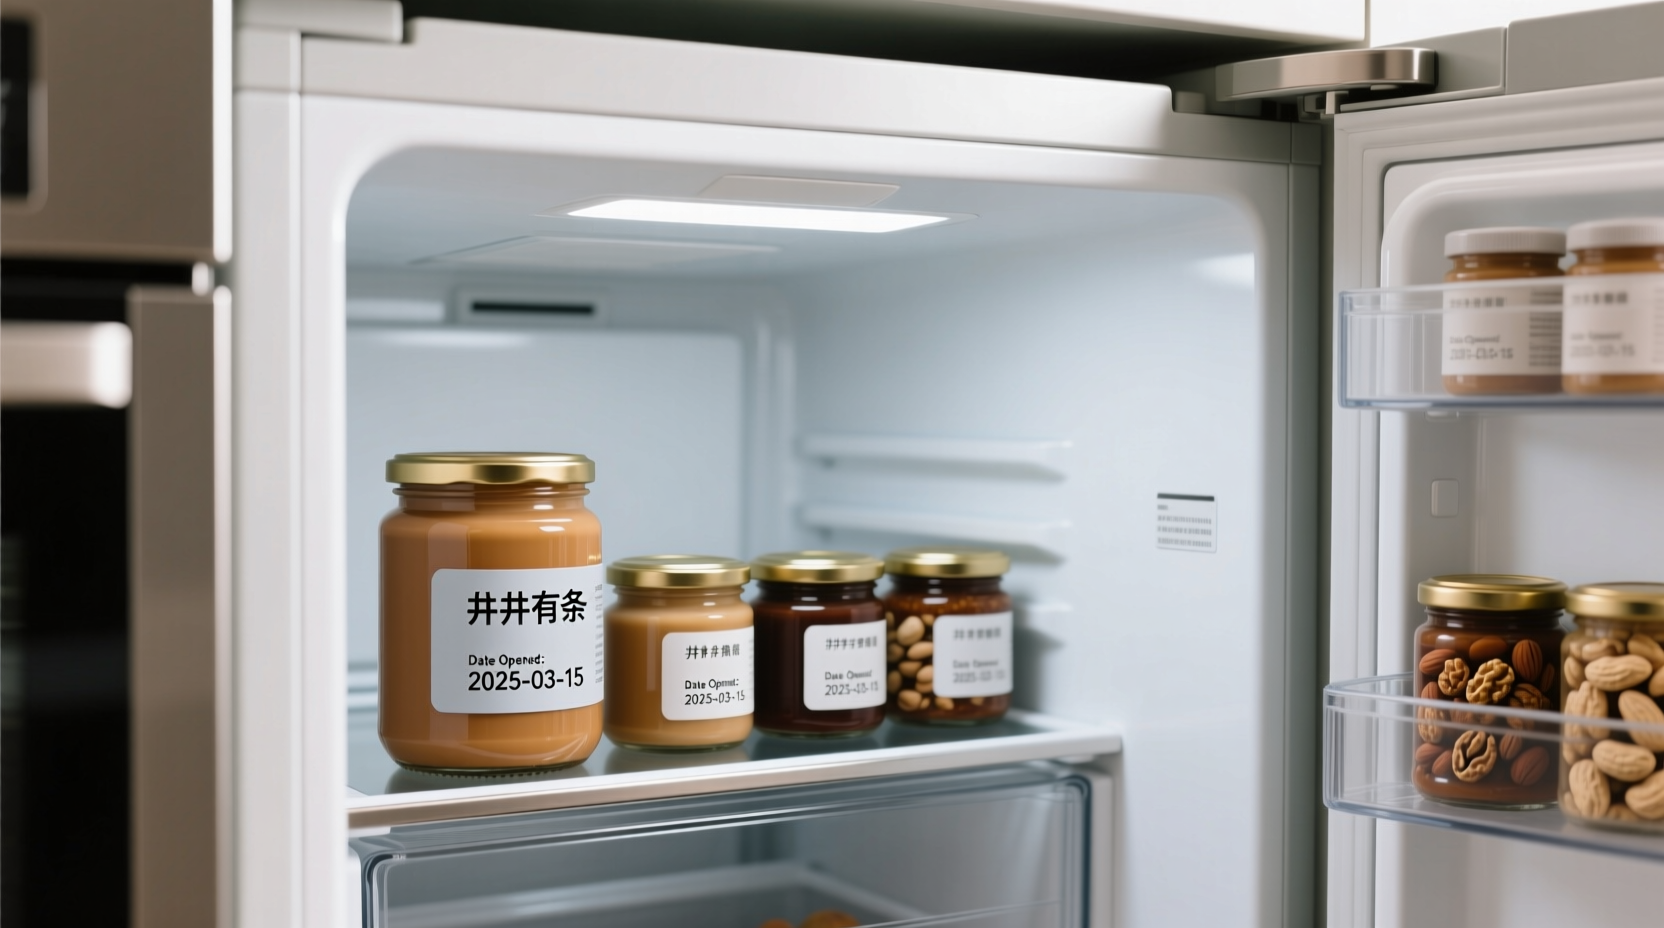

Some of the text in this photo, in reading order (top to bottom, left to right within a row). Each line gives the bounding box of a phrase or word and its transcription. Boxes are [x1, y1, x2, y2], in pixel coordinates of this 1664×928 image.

[467, 588, 588, 626] 井井有条
[468, 655, 496, 666] Date
[468, 666, 584, 691] 2025-03-15
